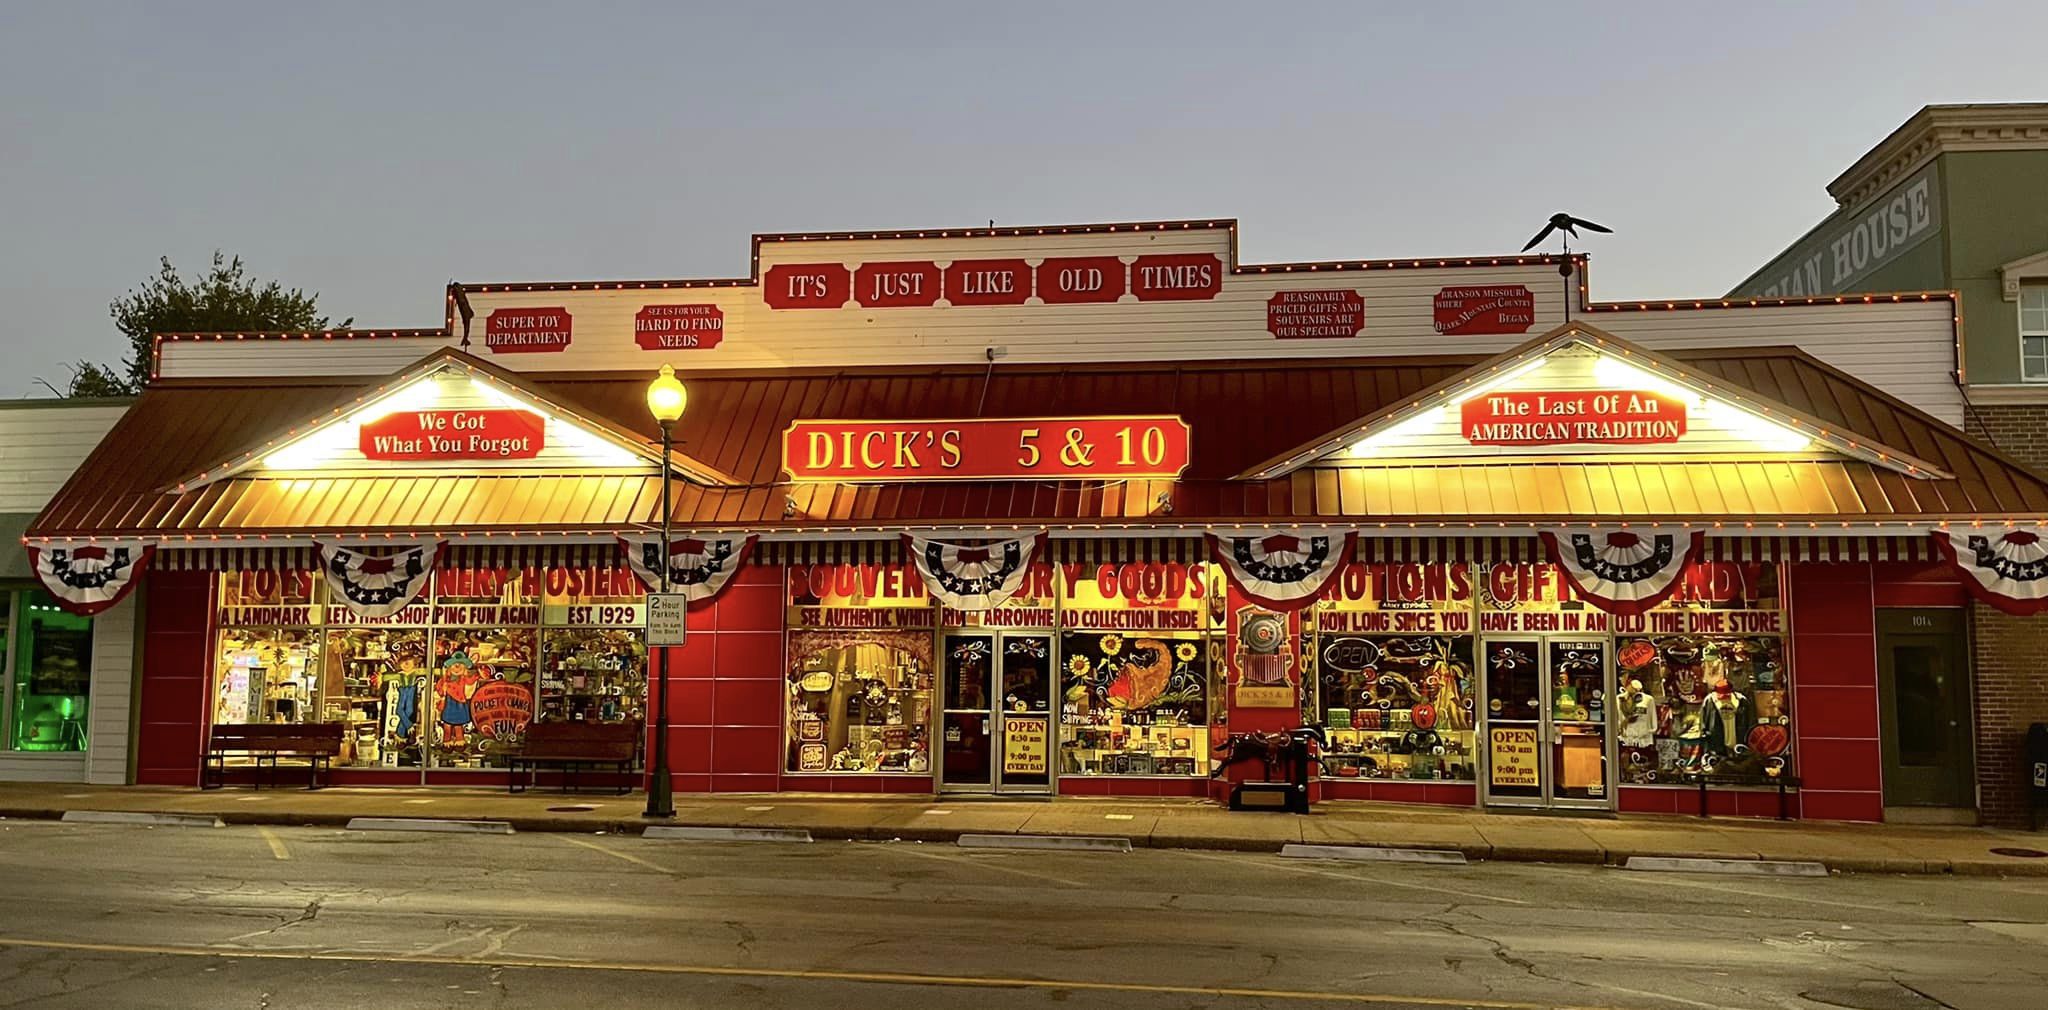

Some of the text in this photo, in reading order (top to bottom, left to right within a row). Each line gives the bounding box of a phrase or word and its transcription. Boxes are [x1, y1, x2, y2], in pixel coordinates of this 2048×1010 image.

[1831, 178, 1930, 286] HOUSE
[787, 264, 1212, 300] IT'S JUST LIKE OLD TIMES
[1284, 291, 1347, 303] REASONABLY
[1441, 288, 1525, 299] BRANSON MISSOURI
[1270, 303, 1360, 314] PRICED GIFTS AND
[1436, 300, 1463, 309] WHERE
[648, 307, 710, 316] SEE US FOR YOUR
[496, 315, 561, 329] SUPER TOY
[636, 317, 722, 332] HARD TO FIND
[1276, 313, 1355, 325] SOUVENIRS ARE
[1277, 325, 1354, 337] OUR SPECIALTY
[487, 331, 569, 346] DEPARTMENT
[658, 334, 699, 347] NEEDS
[1488, 394, 1658, 416] The Last Of An
[418, 412, 487, 430] We Got
[1470, 420, 1679, 441] AMERICAN TRADITION
[374, 435, 529, 455] What You Forgot
[806, 426, 1166, 469] DICK'S 5 & 10
[1097, 561, 1205, 599] GOODS
[651, 597, 680, 609] 2 Hour
[221, 607, 311, 625] A LANDMARK
[326, 607, 356, 624] LETS
[470, 607, 496, 624] FUN
[499, 607, 540, 624] AGAIN
[568, 606, 635, 624] EST. 1929
[651, 610, 680, 620] Parking
[801, 608, 821, 626] SEE
[825, 608, 892, 626] AUTHENTIC
[896, 608, 936, 627] WHITE
[1082, 609, 1151, 628] COLLECTION
[1158, 609, 1198, 628] INSIDE
[1318, 612, 1780, 632] HOW LONG SINCE YOU HAVE BEEN IN AN OLD TIME DIME STORE
[1328, 646, 1373, 663] OPEN
[1008, 721, 1045, 732] OPEN
[1011, 734, 1028, 742] 8:30
[1493, 731, 1535, 743] OPEN
[1496, 744, 1517, 753] 8:30
[1010, 752, 1027, 760] 9:00
[1510, 756, 1520, 764] to
[1496, 765, 1517, 774] 9:00
